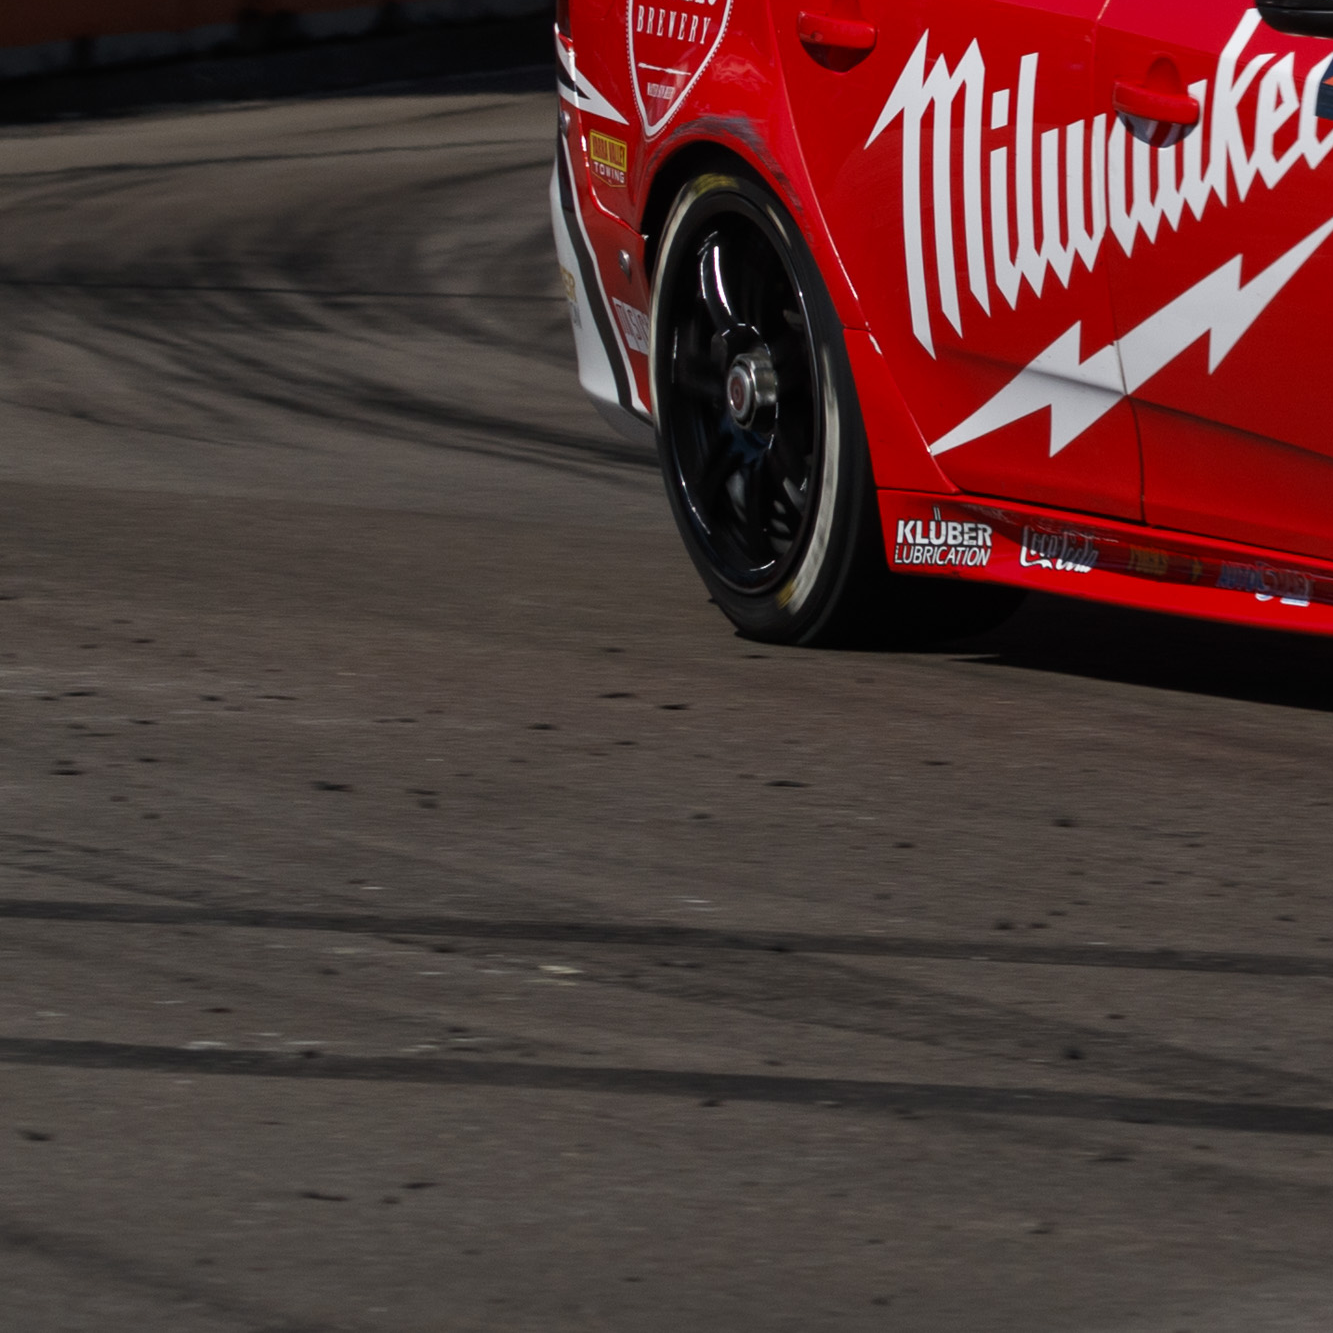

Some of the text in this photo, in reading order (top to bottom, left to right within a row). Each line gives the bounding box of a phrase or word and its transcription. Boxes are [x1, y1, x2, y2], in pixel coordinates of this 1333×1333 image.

[636, 5, 711, 44] BREWERY
[594, 162, 625, 183] TOWING
[894, 544, 992, 567] LUBRICATION
